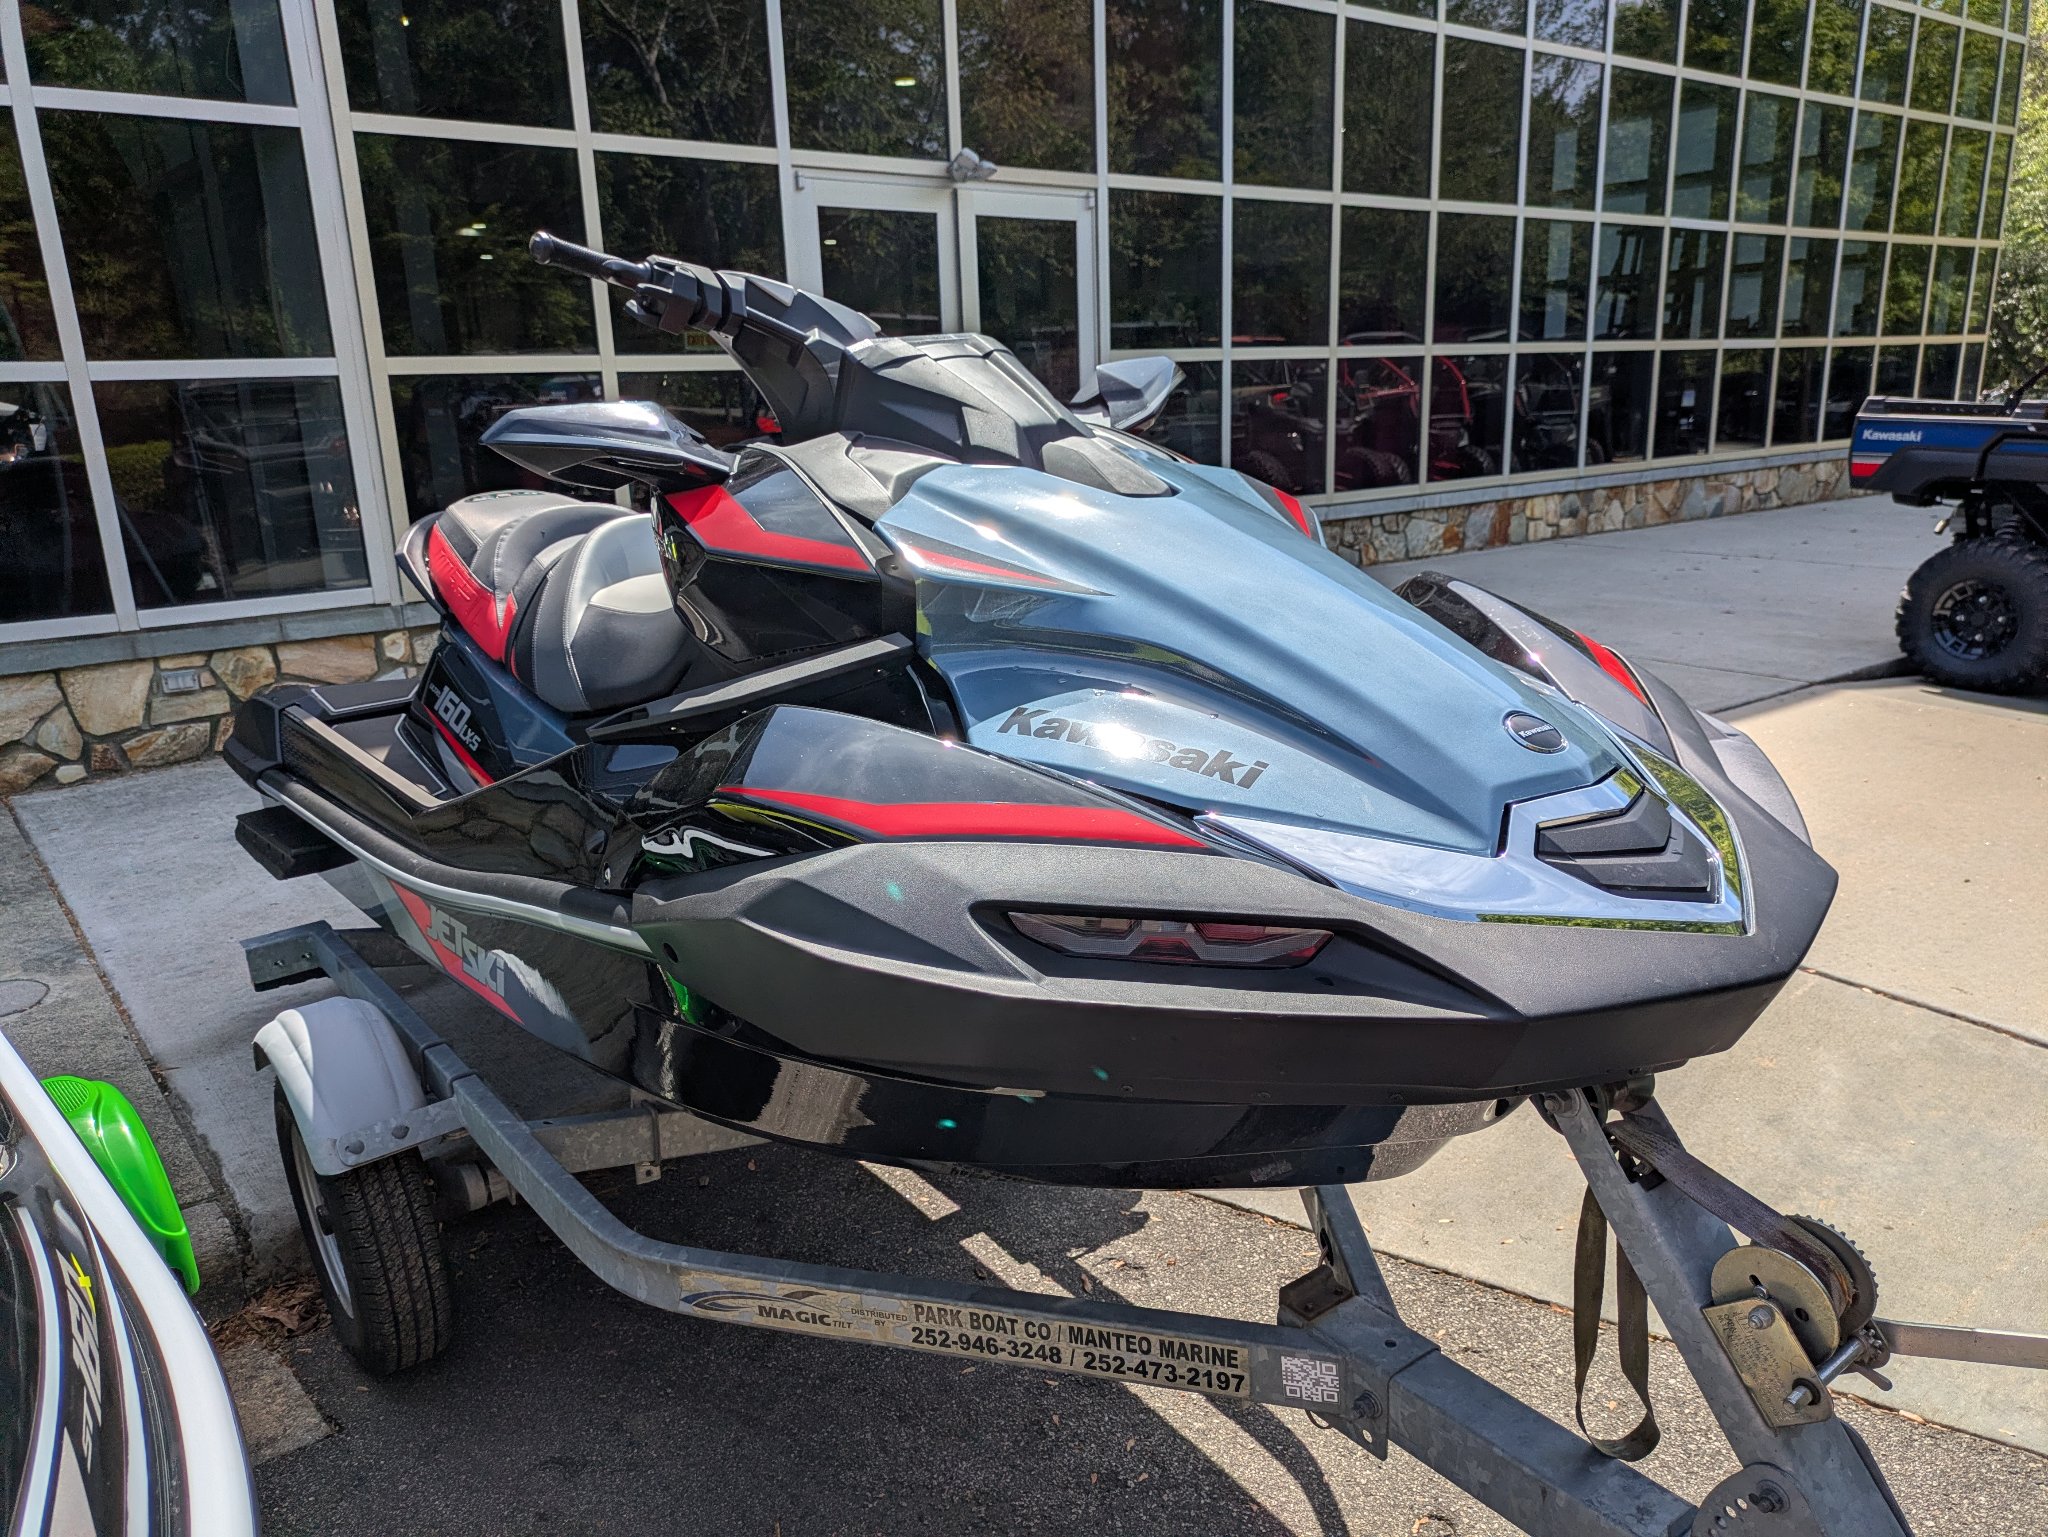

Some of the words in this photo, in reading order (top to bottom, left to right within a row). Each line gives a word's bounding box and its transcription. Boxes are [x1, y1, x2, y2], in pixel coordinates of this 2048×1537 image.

[1862, 429, 1922, 442] Kawasaki
[996, 706, 1270, 790] Kawsaki
[757, 1305, 832, 1327] MAGIC
[832, 1320, 854, 1330] TILT
[851, 1308, 909, 1322] DISTRIBUTED
[914, 1304, 964, 1328] PARK
[968, 1312, 1018, 1336] BOAT
[1025, 1321, 1052, 1341] CO
[1068, 1325, 1152, 1355] MANTEO
[1158, 1339, 1239, 1370] MARINE
[911, 1327, 1062, 1364] 252-946-3248
[1083, 1351, 1246, 1392] 252-473-2197
